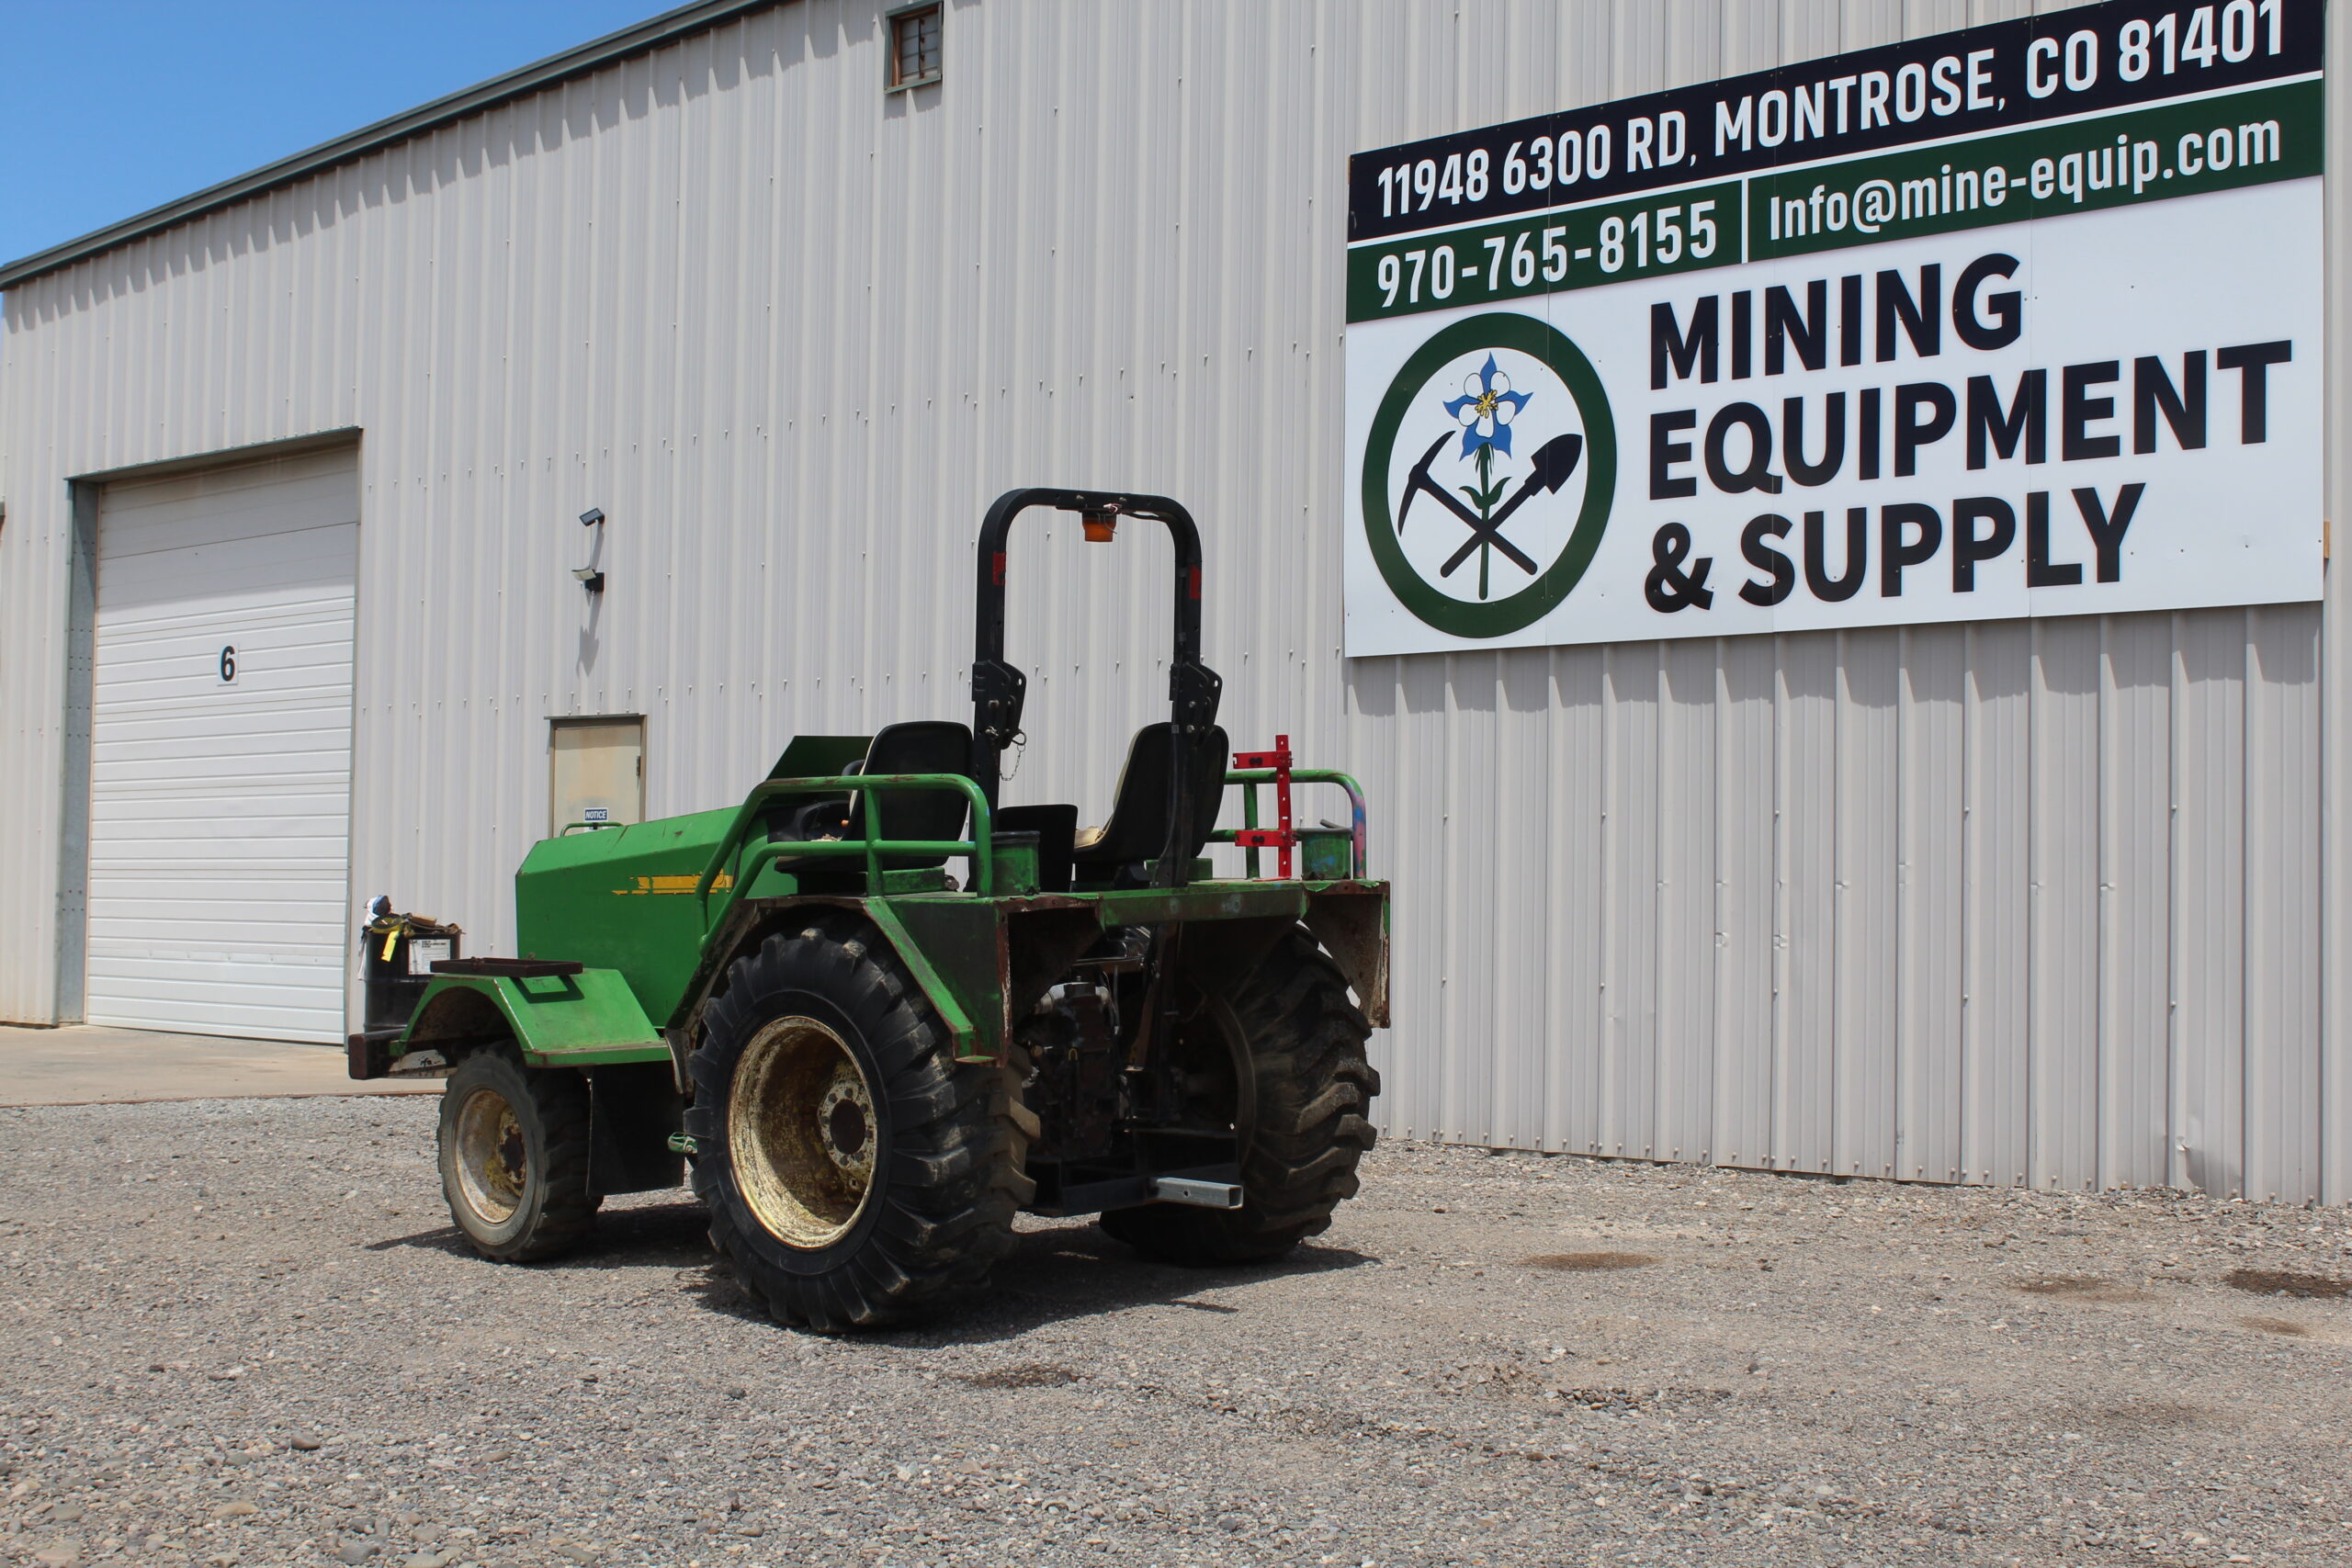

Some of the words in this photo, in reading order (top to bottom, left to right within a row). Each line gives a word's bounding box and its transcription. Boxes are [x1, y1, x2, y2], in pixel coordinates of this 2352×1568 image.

[1377, 150, 1489, 218] 11948
[1503, 124, 1611, 195] 6300
[1627, 110, 1698, 173] RD,
[1715, 48, 2006, 156] MONTROSE,
[2027, 29, 2098, 99] CO
[2119, 0, 2282, 82] 81401
[1770, 119, 2279, 241] Info@mine-equip.com
[1377, 199, 1716, 308] 970-765-8155
[1651, 253, 2022, 390] MINING
[1649, 339, 2292, 501] EQUIPMENT
[1644, 522, 1714, 614] &
[1737, 482, 2146, 607] SUPPLY
[220, 645, 235, 682] 6
[585, 810, 606, 819] NOTICE
